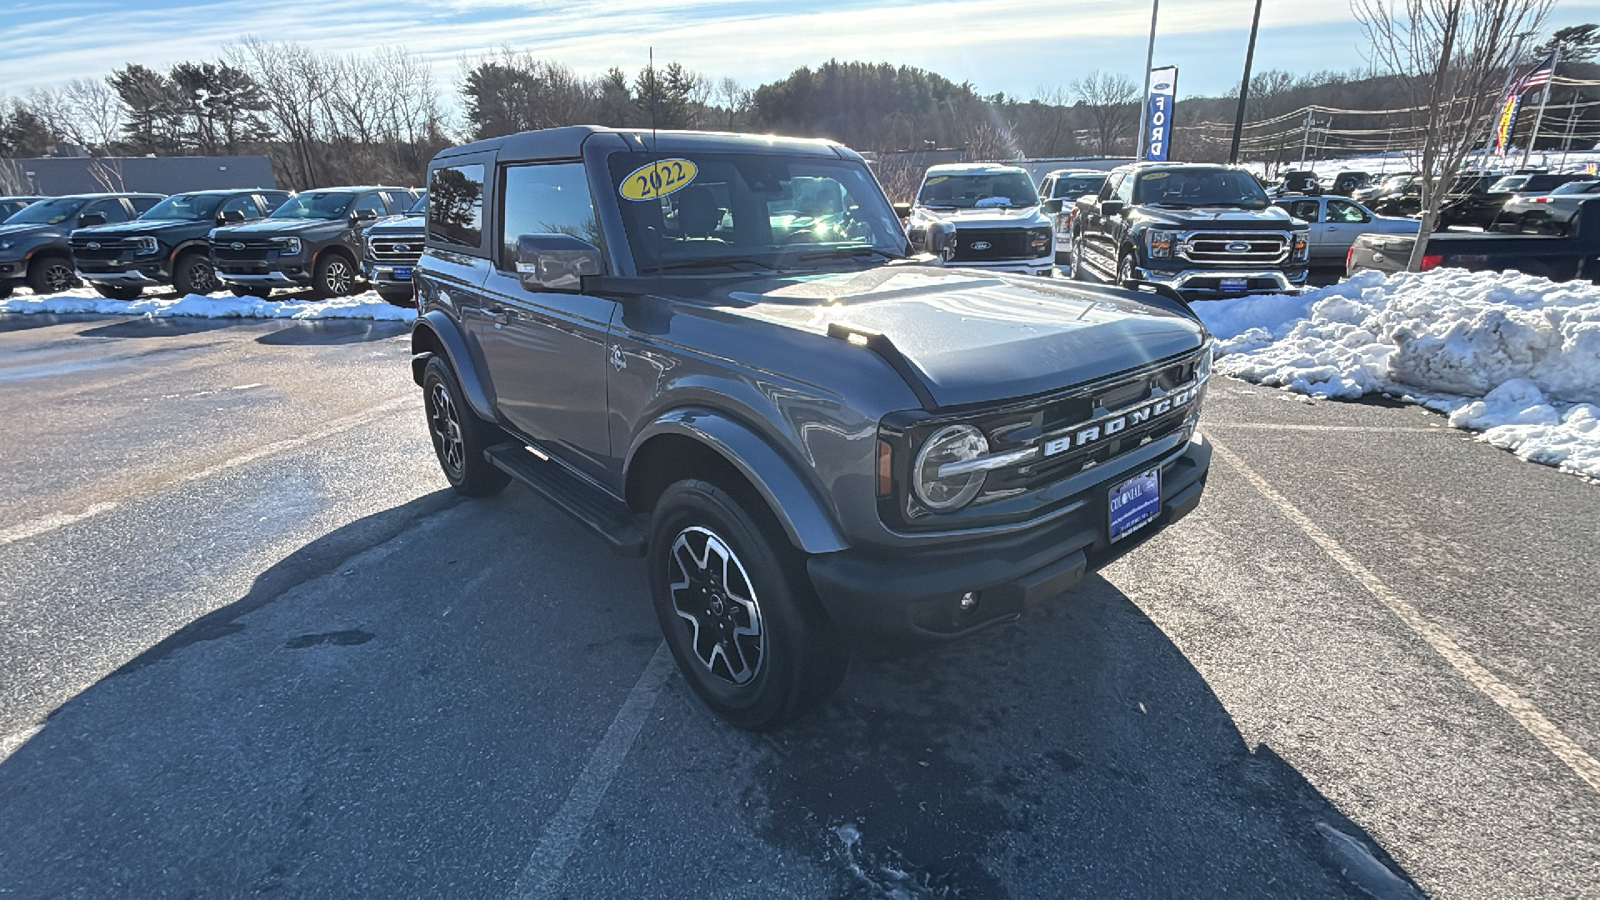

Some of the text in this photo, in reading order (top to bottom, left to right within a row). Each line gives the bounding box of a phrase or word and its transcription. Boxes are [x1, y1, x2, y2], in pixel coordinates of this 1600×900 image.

[636, 162, 686, 197] 2022
[1044, 391, 1190, 457] BRONCO
[1110, 485, 1143, 512] COLONIAL
